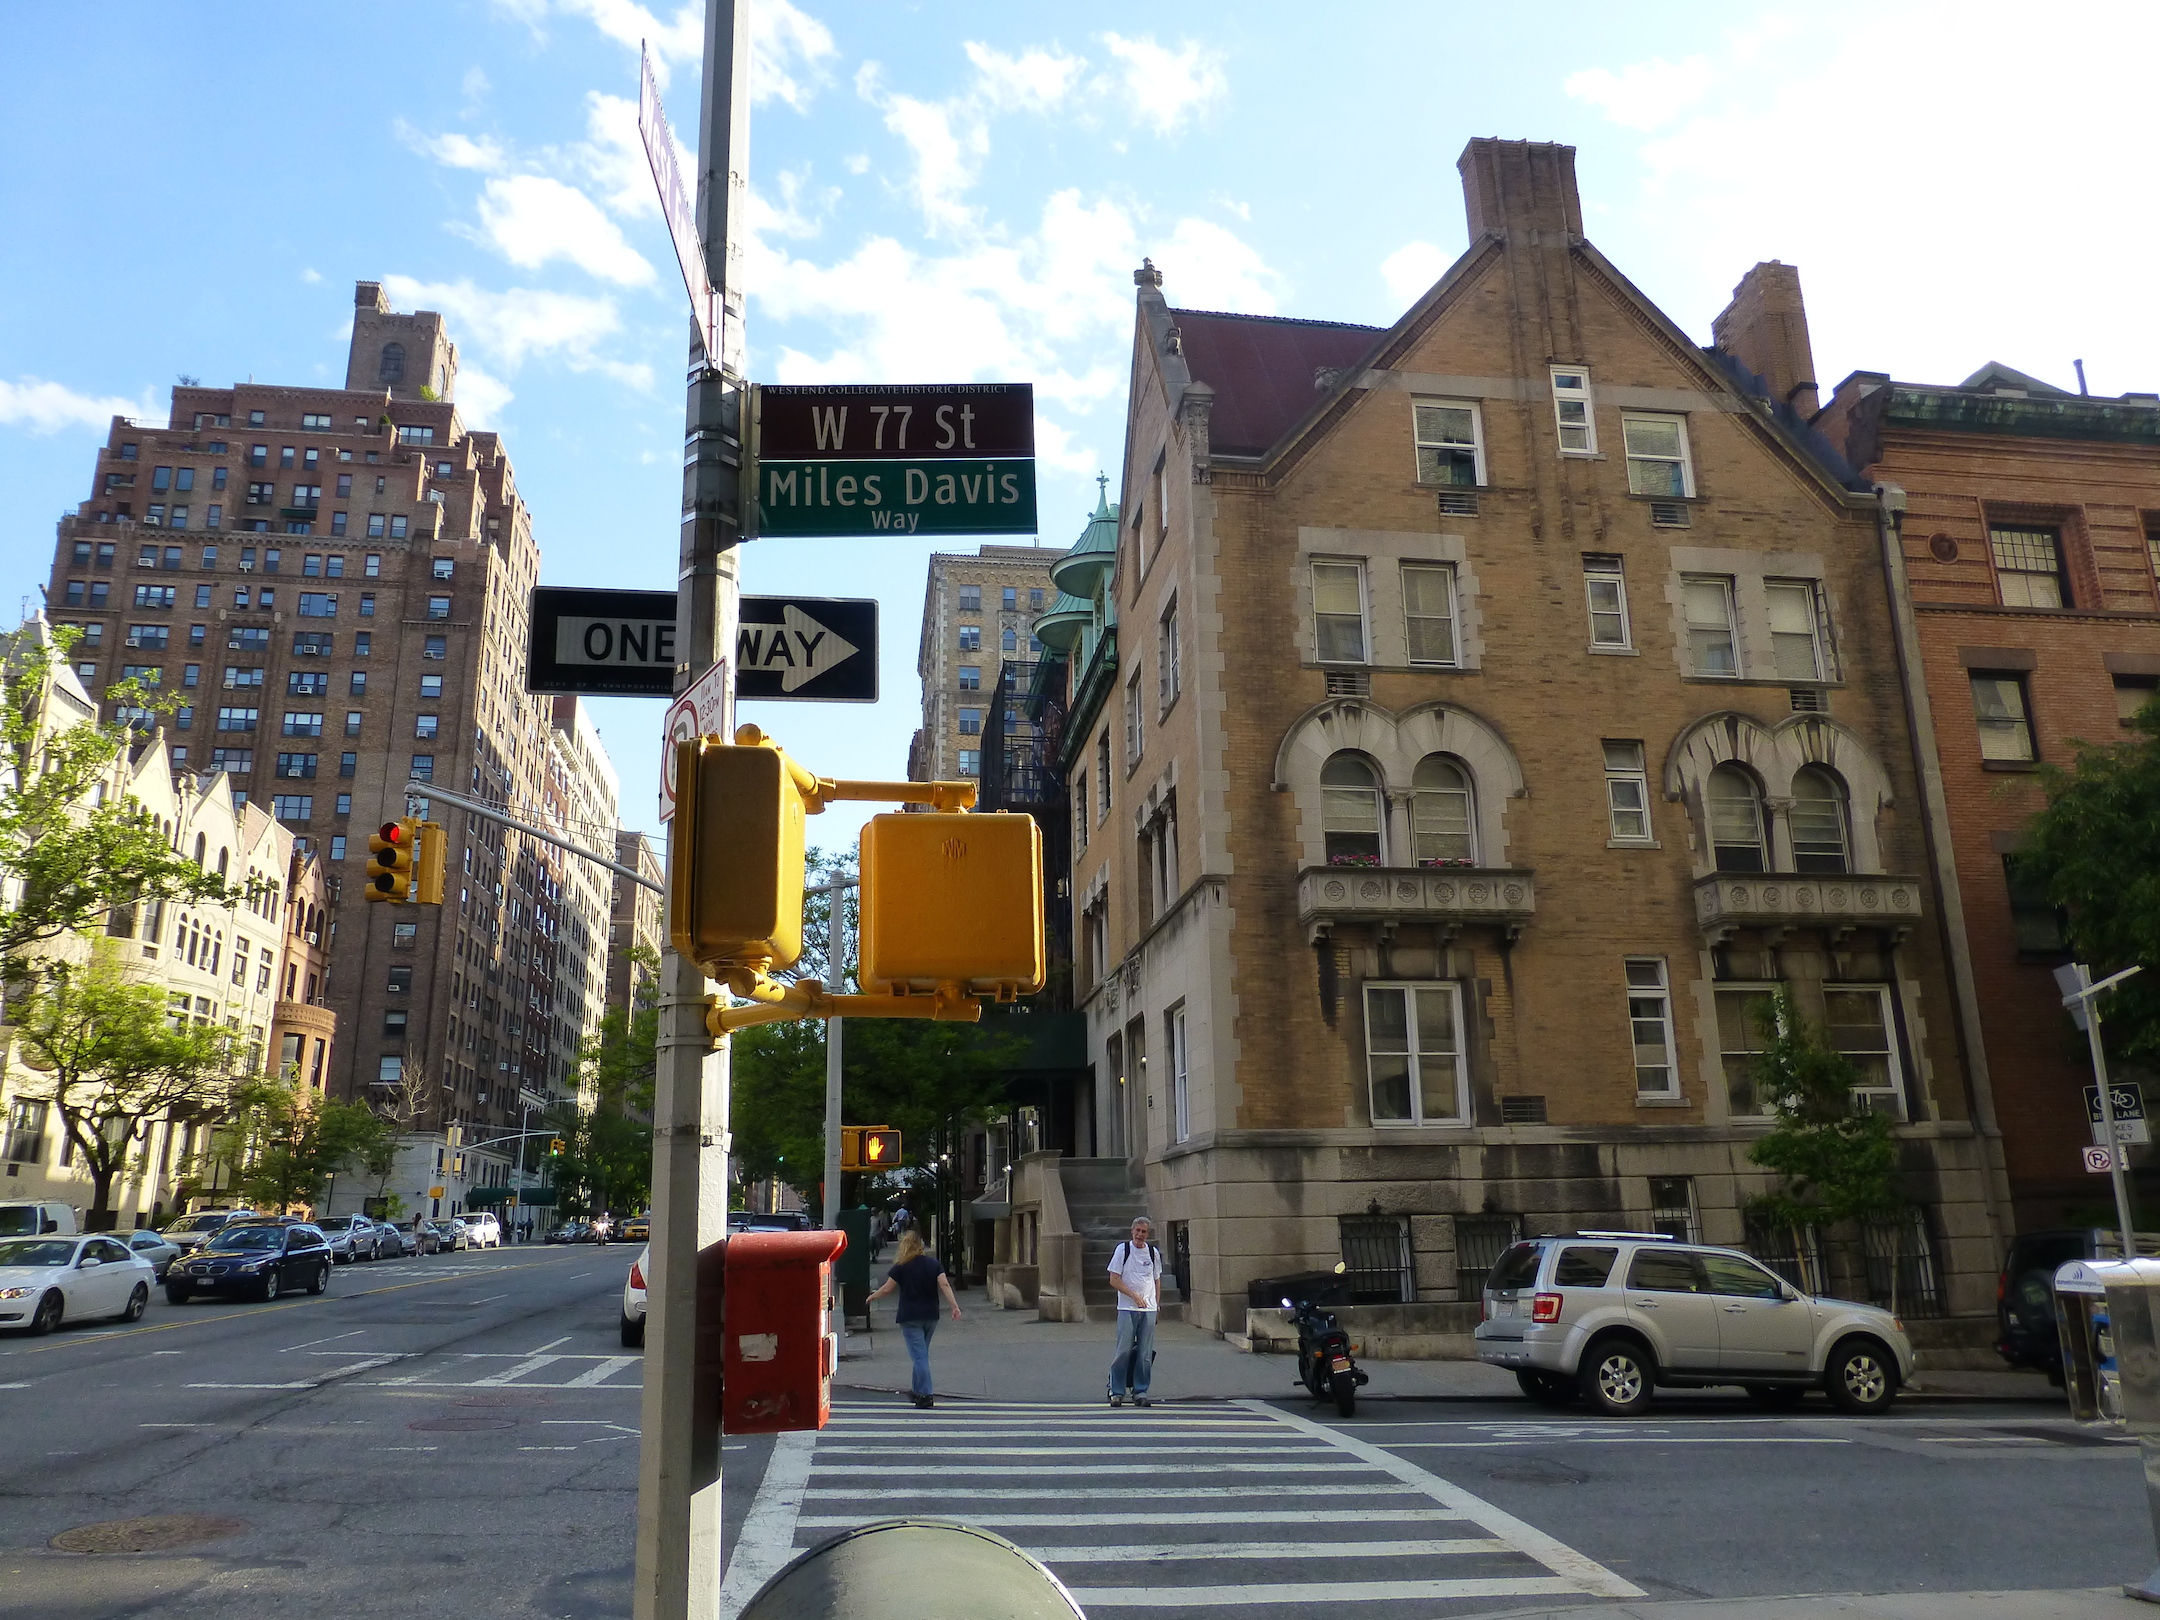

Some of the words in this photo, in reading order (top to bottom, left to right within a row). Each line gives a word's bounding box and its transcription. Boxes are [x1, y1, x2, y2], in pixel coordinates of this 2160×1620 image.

[767, 386, 799, 395] WEST
[801, 386, 826, 395] END
[828, 385, 899, 395] COLLEGIATE
[902, 385, 955, 394] HISTORIC
[957, 384, 1008, 394] DISTRICT
[811, 406, 848, 450] W
[869, 405, 913, 450] 77
[934, 403, 976, 450] St
[769, 466, 882, 507] Miles
[905, 464, 1020, 505] Davis
[871, 510, 919, 534] Way
[584, 622, 675, 662] ONE
[737, 629, 826, 667] WAY
[2116, 1110, 2142, 1119] LANE
[2115, 1132, 2132, 1140] NLY
